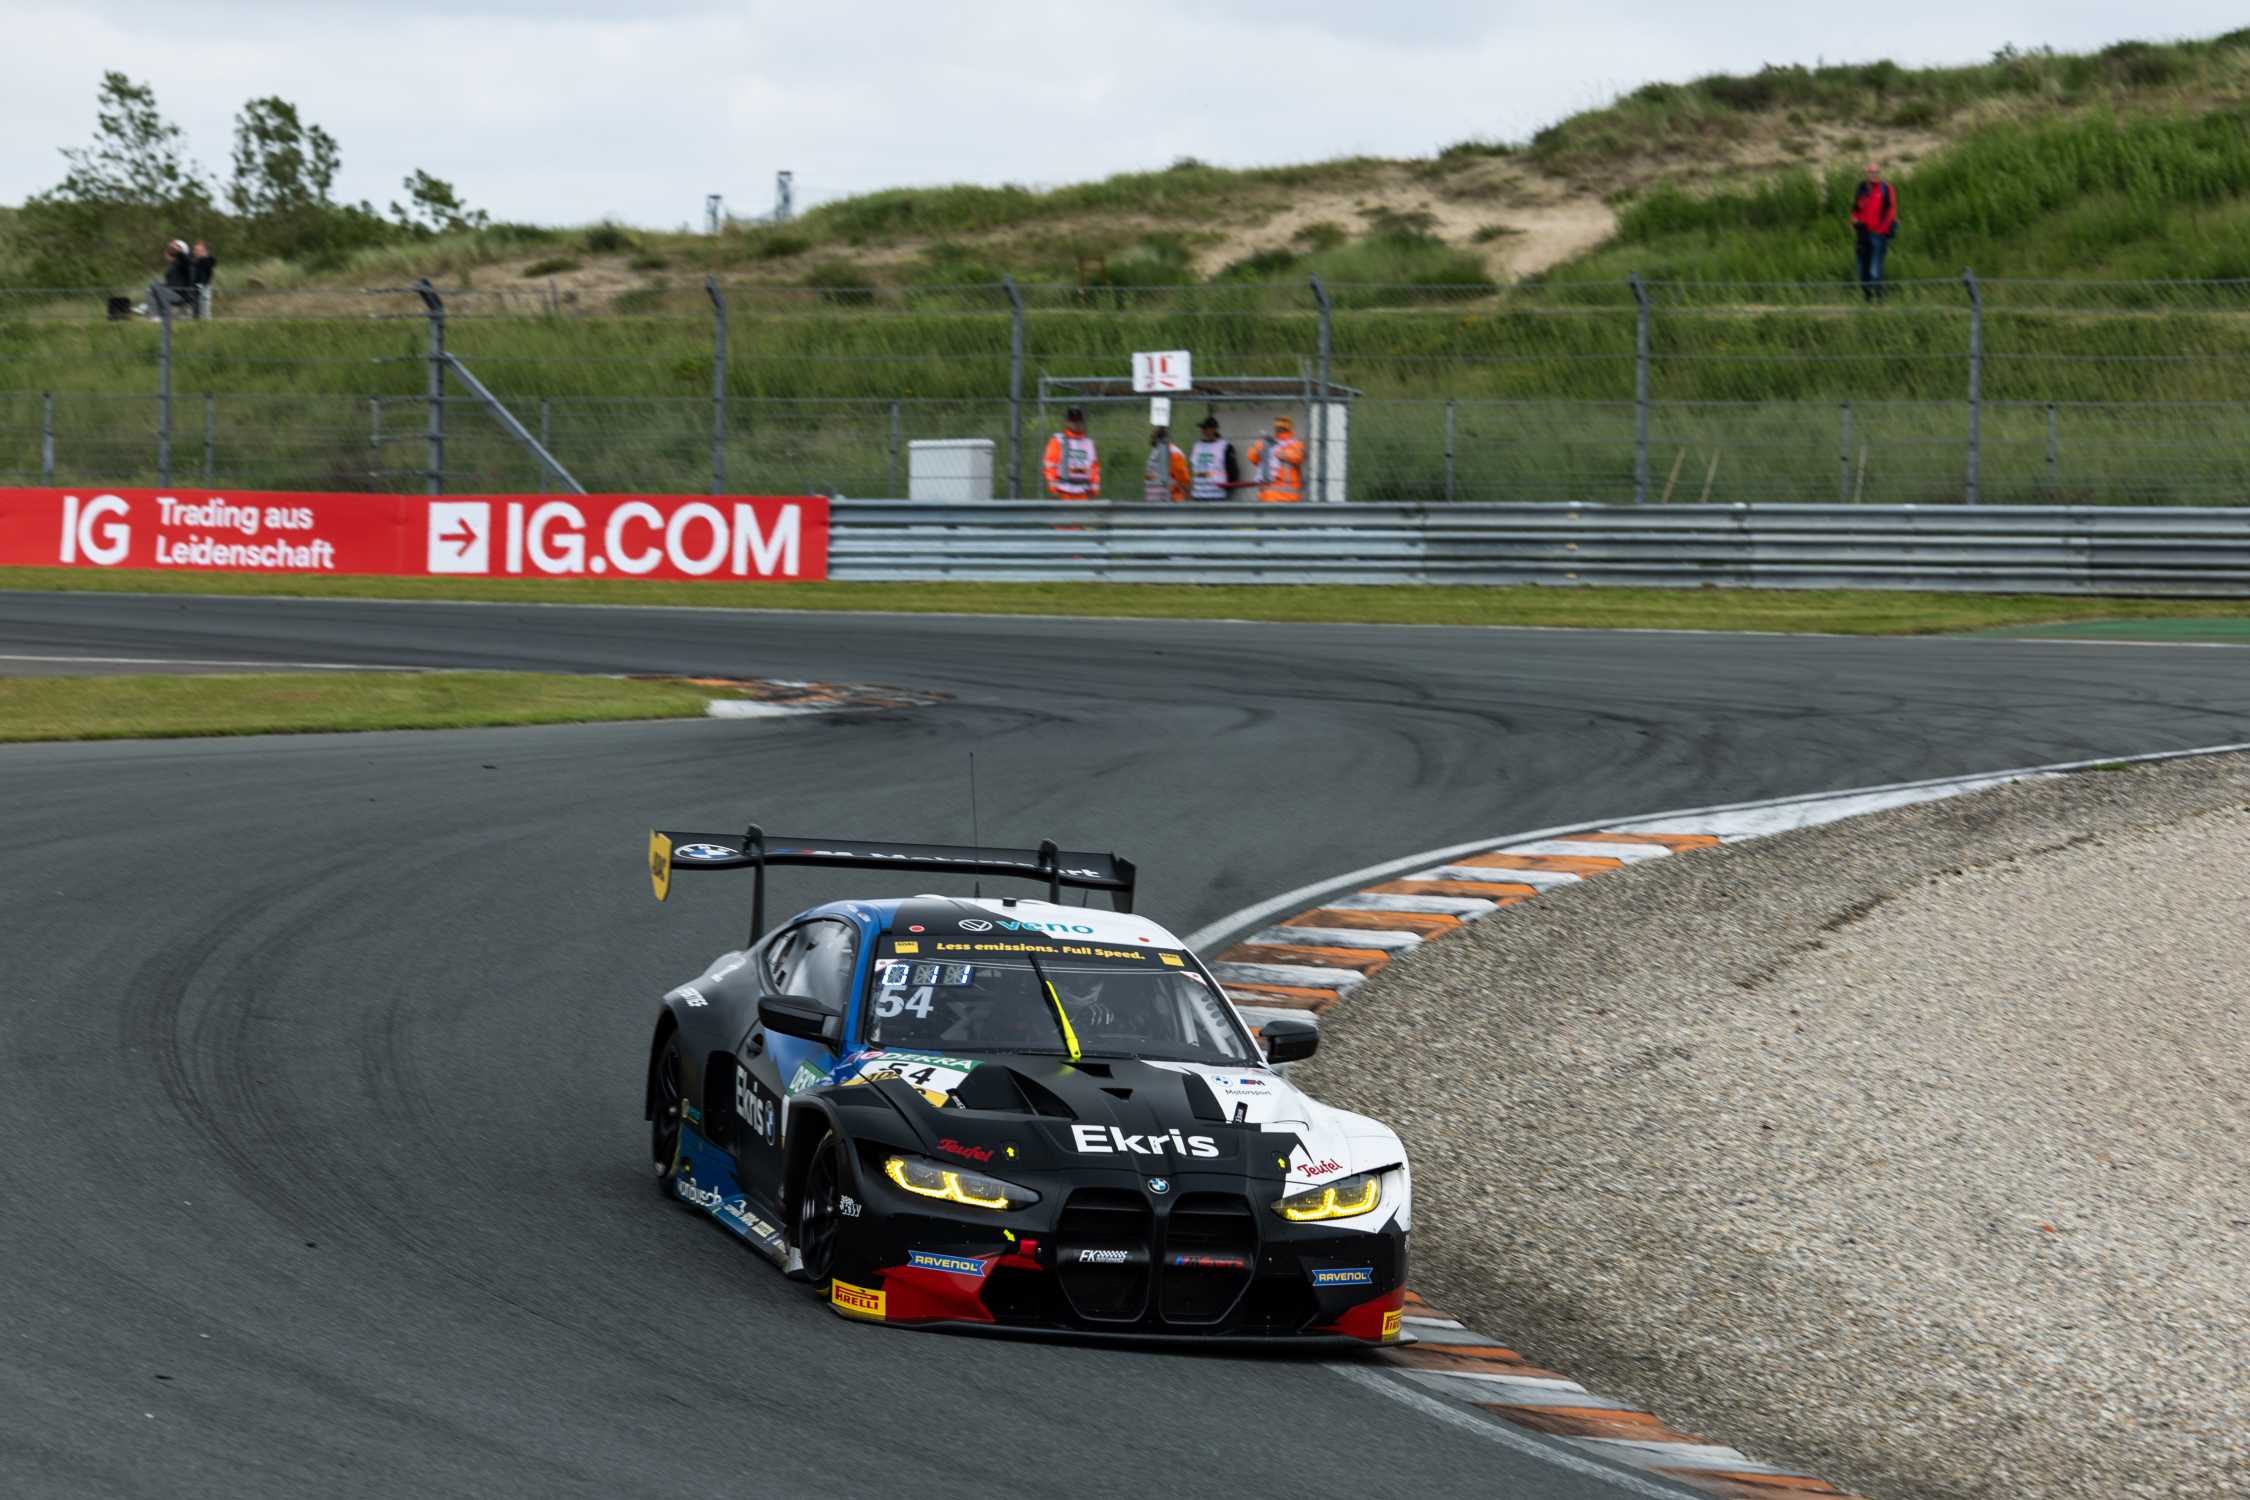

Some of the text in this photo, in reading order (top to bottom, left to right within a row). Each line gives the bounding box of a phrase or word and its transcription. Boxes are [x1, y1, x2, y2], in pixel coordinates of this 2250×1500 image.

[156, 497, 314, 533] Trading aus
[60, 495, 130, 566] IG
[505, 502, 801, 577] IG.COM
[155, 534, 335, 569] Leidenschaft
[995, 920, 1094, 935] veno
[936, 942, 972, 951] Less
[977, 942, 1058, 954] emissions.
[1062, 945, 1091, 957] Full
[1095, 948, 1146, 961] Speed.
[875, 986, 935, 1020] 54
[877, 1053, 973, 1070] DEKRA
[1071, 1124, 1220, 1158] Ekris
[1296, 1158, 1343, 1177] Teufel
[914, 1256, 978, 1273] RAVENOL
[1318, 1271, 1368, 1282] RAVENOL
[834, 1284, 880, 1310] PIRELLI
